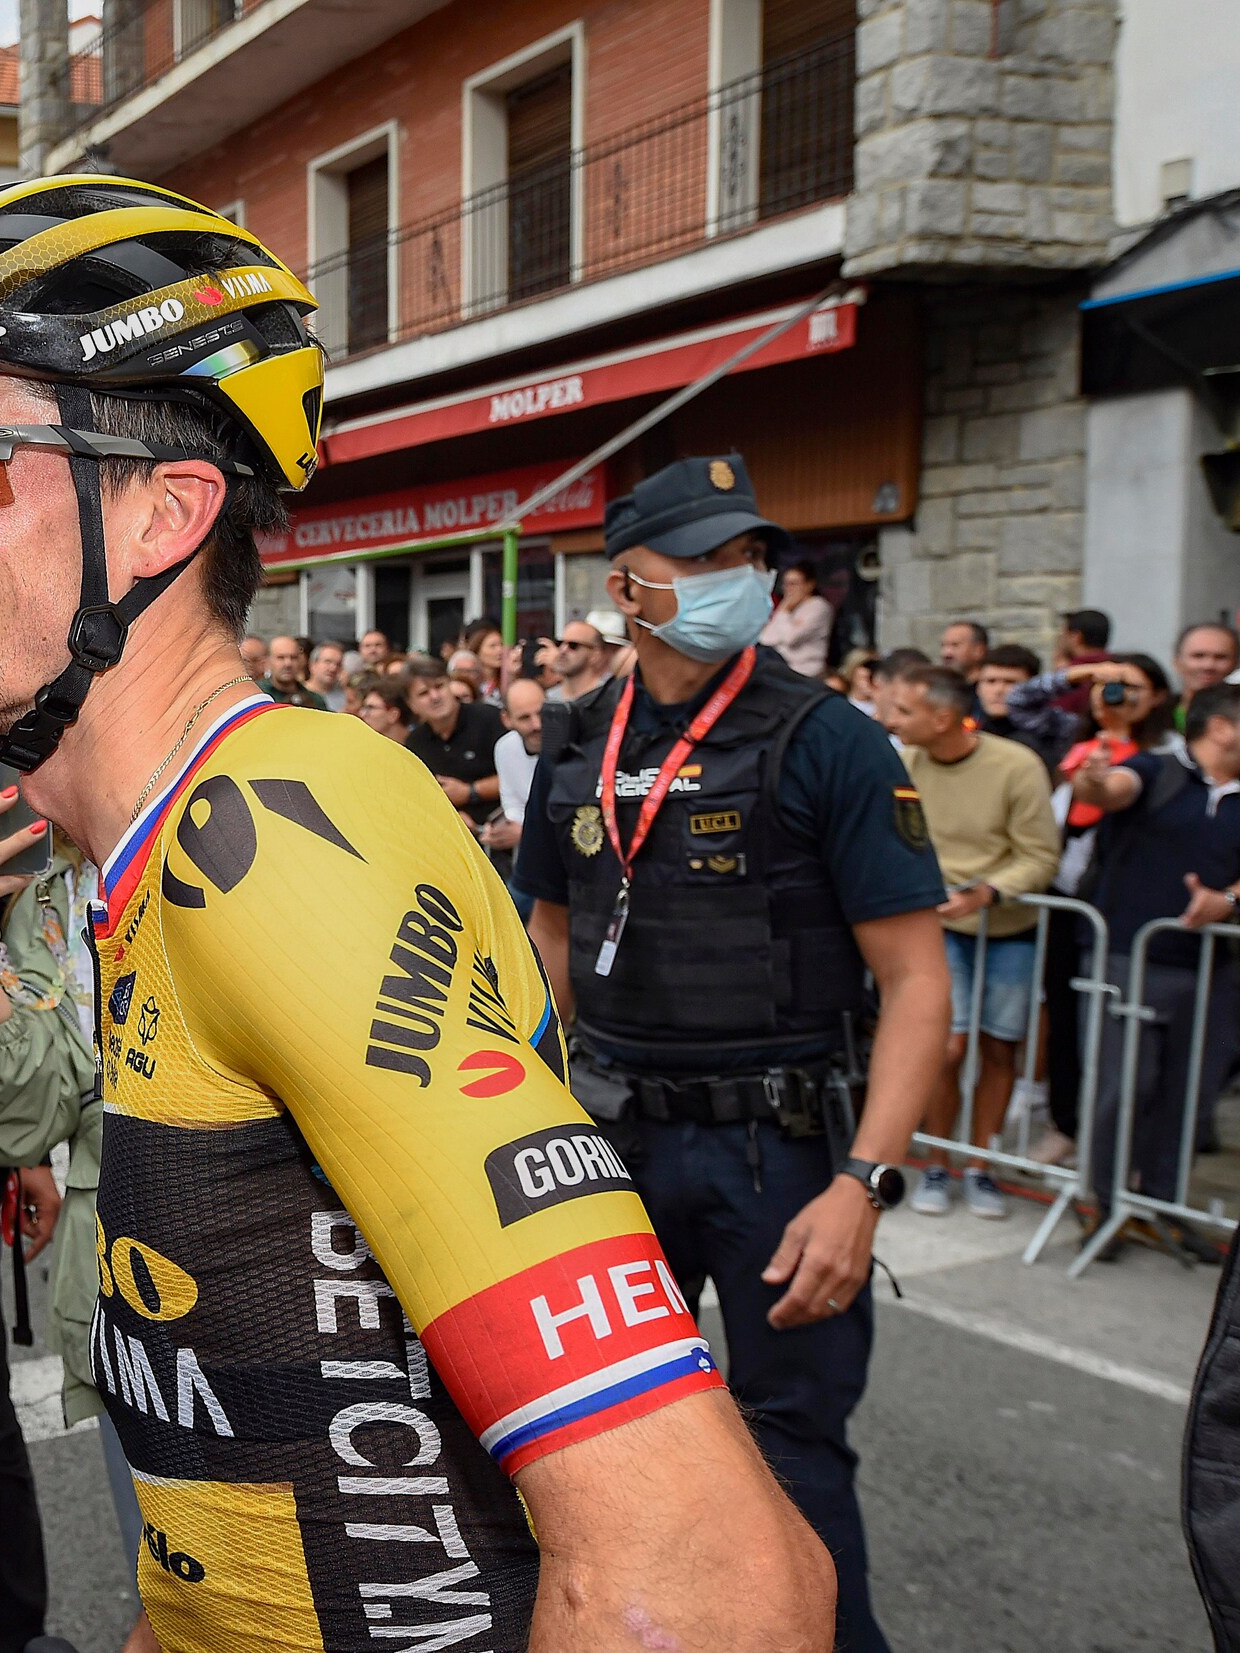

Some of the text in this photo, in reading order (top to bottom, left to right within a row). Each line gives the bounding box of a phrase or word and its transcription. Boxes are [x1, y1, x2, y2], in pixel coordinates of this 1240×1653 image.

[221, 272, 273, 300] VISMA
[78, 298, 184, 362] JUMBO
[489, 375, 584, 423] MOLPER
[295, 510, 420, 548] CERVECERIA
[424, 488, 518, 530] MOLPER
[365, 883, 465, 1089] JUMBO
[124, 1047, 157, 1080] AGU
